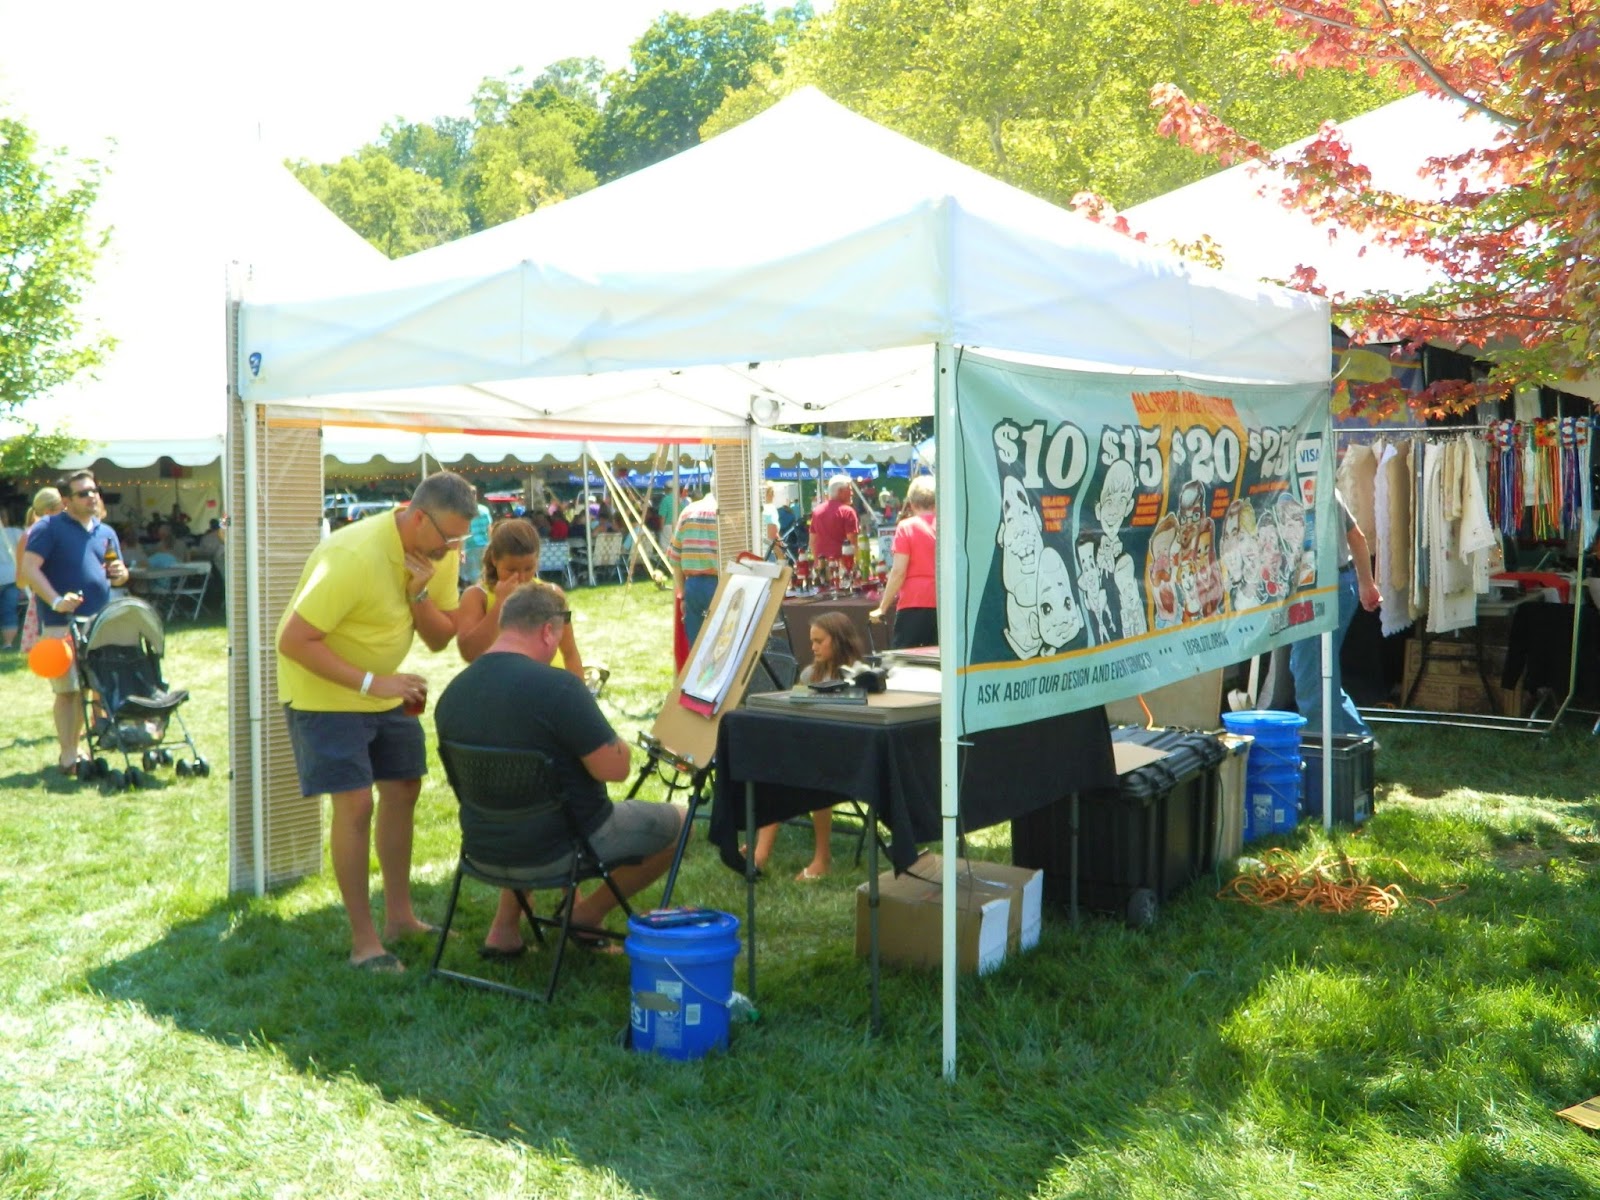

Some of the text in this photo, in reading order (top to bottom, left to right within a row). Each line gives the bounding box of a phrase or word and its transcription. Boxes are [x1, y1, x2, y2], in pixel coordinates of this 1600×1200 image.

[1131, 391, 1157, 413] ALL
[994, 420, 1088, 490] $10
[1101, 426, 1163, 487] $15
[1172, 427, 1240, 485] $20
[1249, 427, 1294, 479] $25
[1300, 448, 1320, 464] VISA
[977, 683, 1000, 706] ASK
[1003, 677, 1038, 701] ABOUT
[1039, 674, 1060, 695] OUR
[1061, 668, 1091, 692] DESIGN
[1092, 665, 1110, 684] AND
[1111, 657, 1129, 680] EVENT
